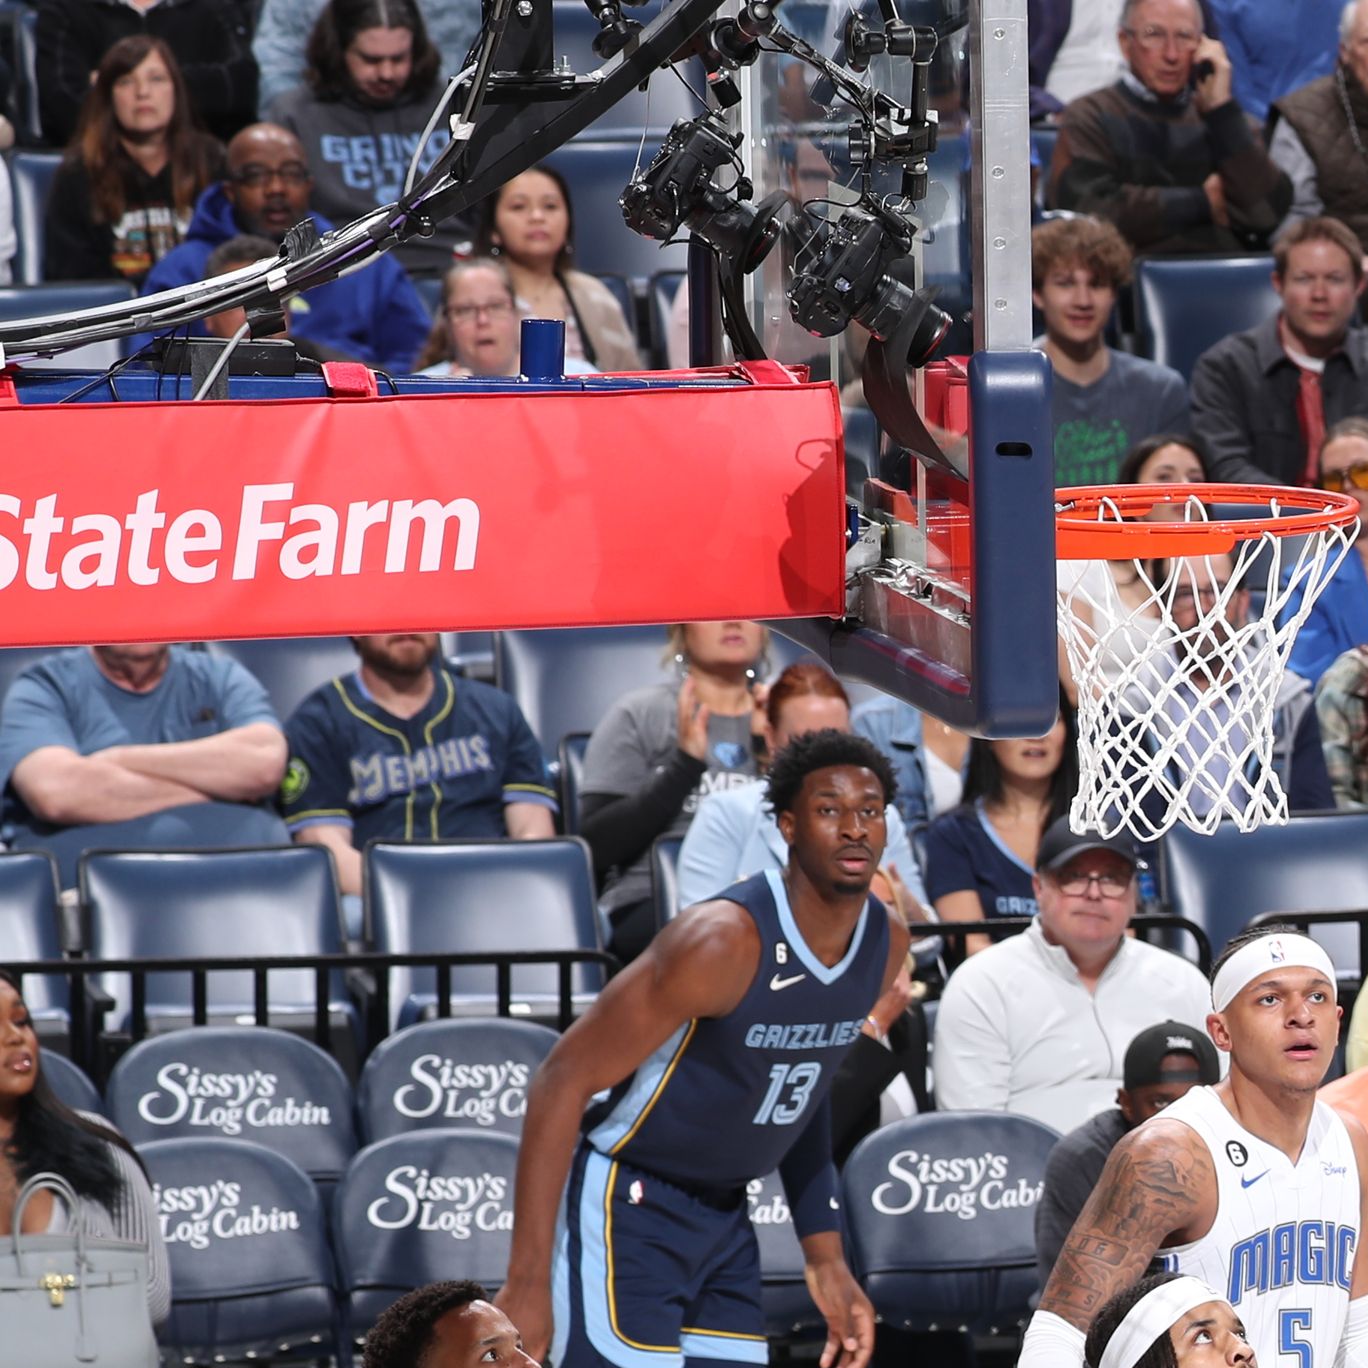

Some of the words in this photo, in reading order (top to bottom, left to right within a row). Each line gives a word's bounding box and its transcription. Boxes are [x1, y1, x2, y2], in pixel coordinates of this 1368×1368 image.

[0, 488, 223, 591] State
[232, 482, 480, 581] Farm
[348, 735, 494, 806] MEMPHIS
[775, 942, 788, 965] 6
[745, 1019, 865, 1050] GRIZZLIES
[138, 1062, 278, 1125] Sissy's
[393, 1054, 530, 1118] Sissy's
[444, 1089, 497, 1126] Log
[752, 1062, 822, 1126] 13
[189, 1098, 245, 1135] Log
[246, 1097, 332, 1127] Cabin
[1230, 1143, 1246, 1166] 6
[152, 1179, 242, 1221] issy's
[367, 1165, 507, 1229] Sissy's
[871, 1150, 1008, 1215] Sissy's
[924, 1185, 977, 1220] Log
[980, 1178, 1045, 1210] Cabi
[158, 1213, 210, 1249] Log
[212, 1205, 300, 1238] Cabin
[417, 1202, 473, 1240] Log
[1226, 1220, 1356, 1308] MAGIC
